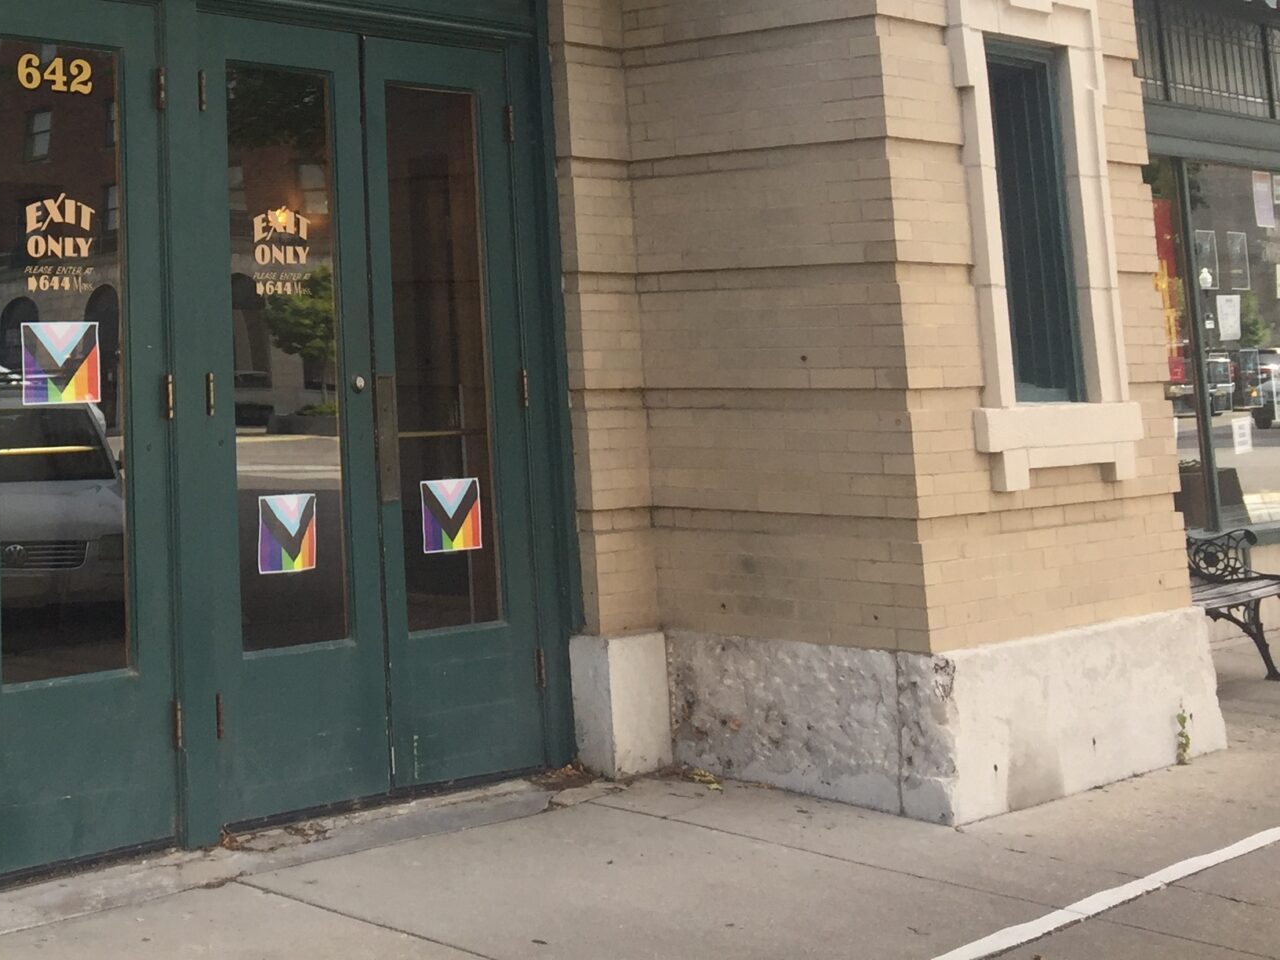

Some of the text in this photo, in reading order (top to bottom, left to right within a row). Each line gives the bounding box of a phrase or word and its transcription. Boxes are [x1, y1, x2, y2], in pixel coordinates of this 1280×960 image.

[17, 52, 94, 95] 642
[25, 192, 96, 234] EXIT
[253, 205, 312, 244] EXIT
[26, 235, 94, 259] ONLY
[254, 244, 310, 266] ONLY
[23, 265, 95, 276] PLEASE ENTER AT
[39, 274, 71, 292] 644
[265, 280, 292, 295] 644
